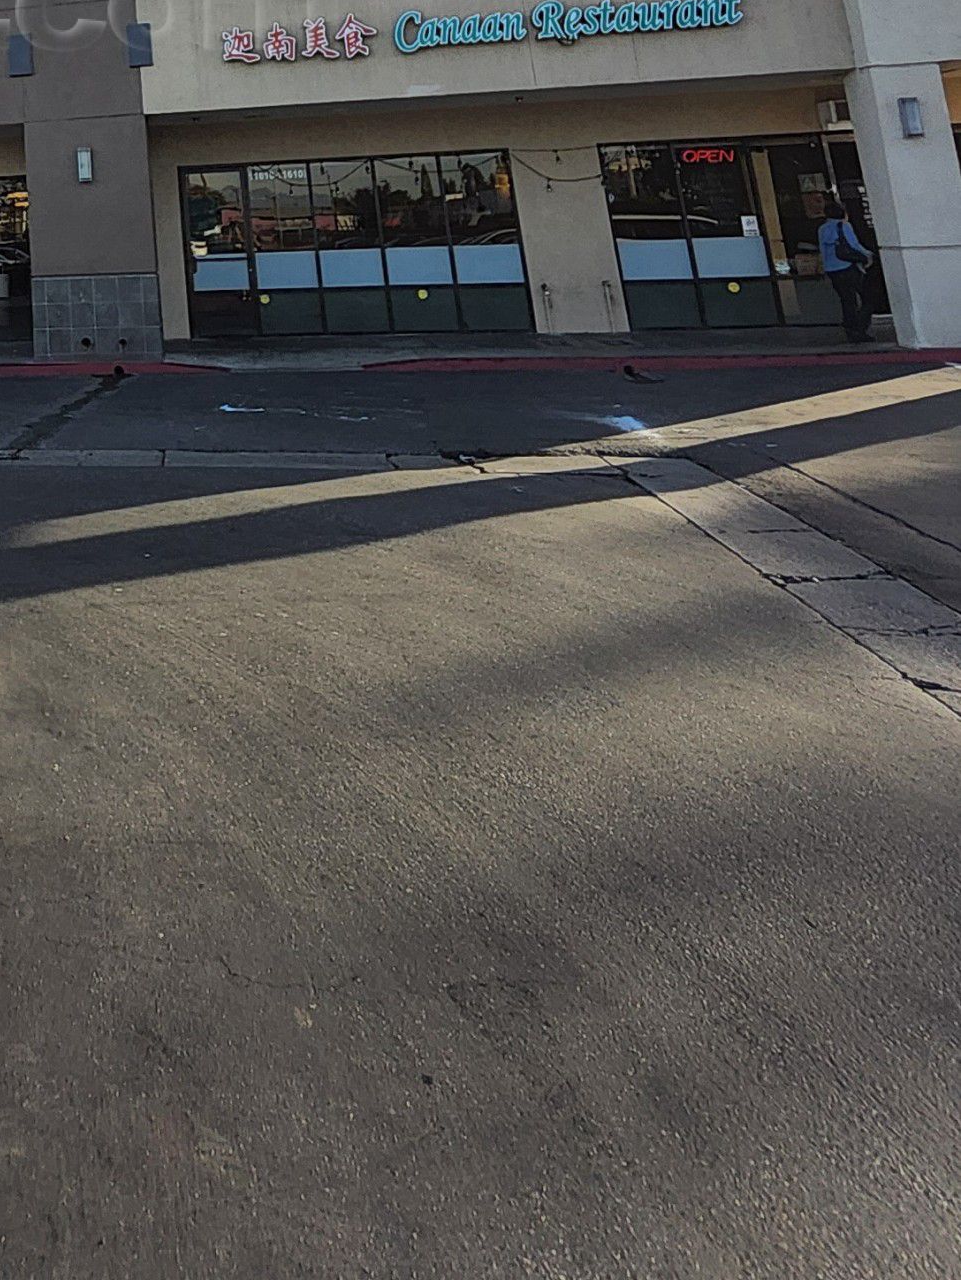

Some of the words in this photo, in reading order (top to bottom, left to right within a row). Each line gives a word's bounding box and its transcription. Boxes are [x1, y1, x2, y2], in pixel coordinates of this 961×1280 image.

[221, 14, 378, 63] 迦南美食
[394, 10, 528, 54] Canaan
[682, 150, 734, 163] OPEN
